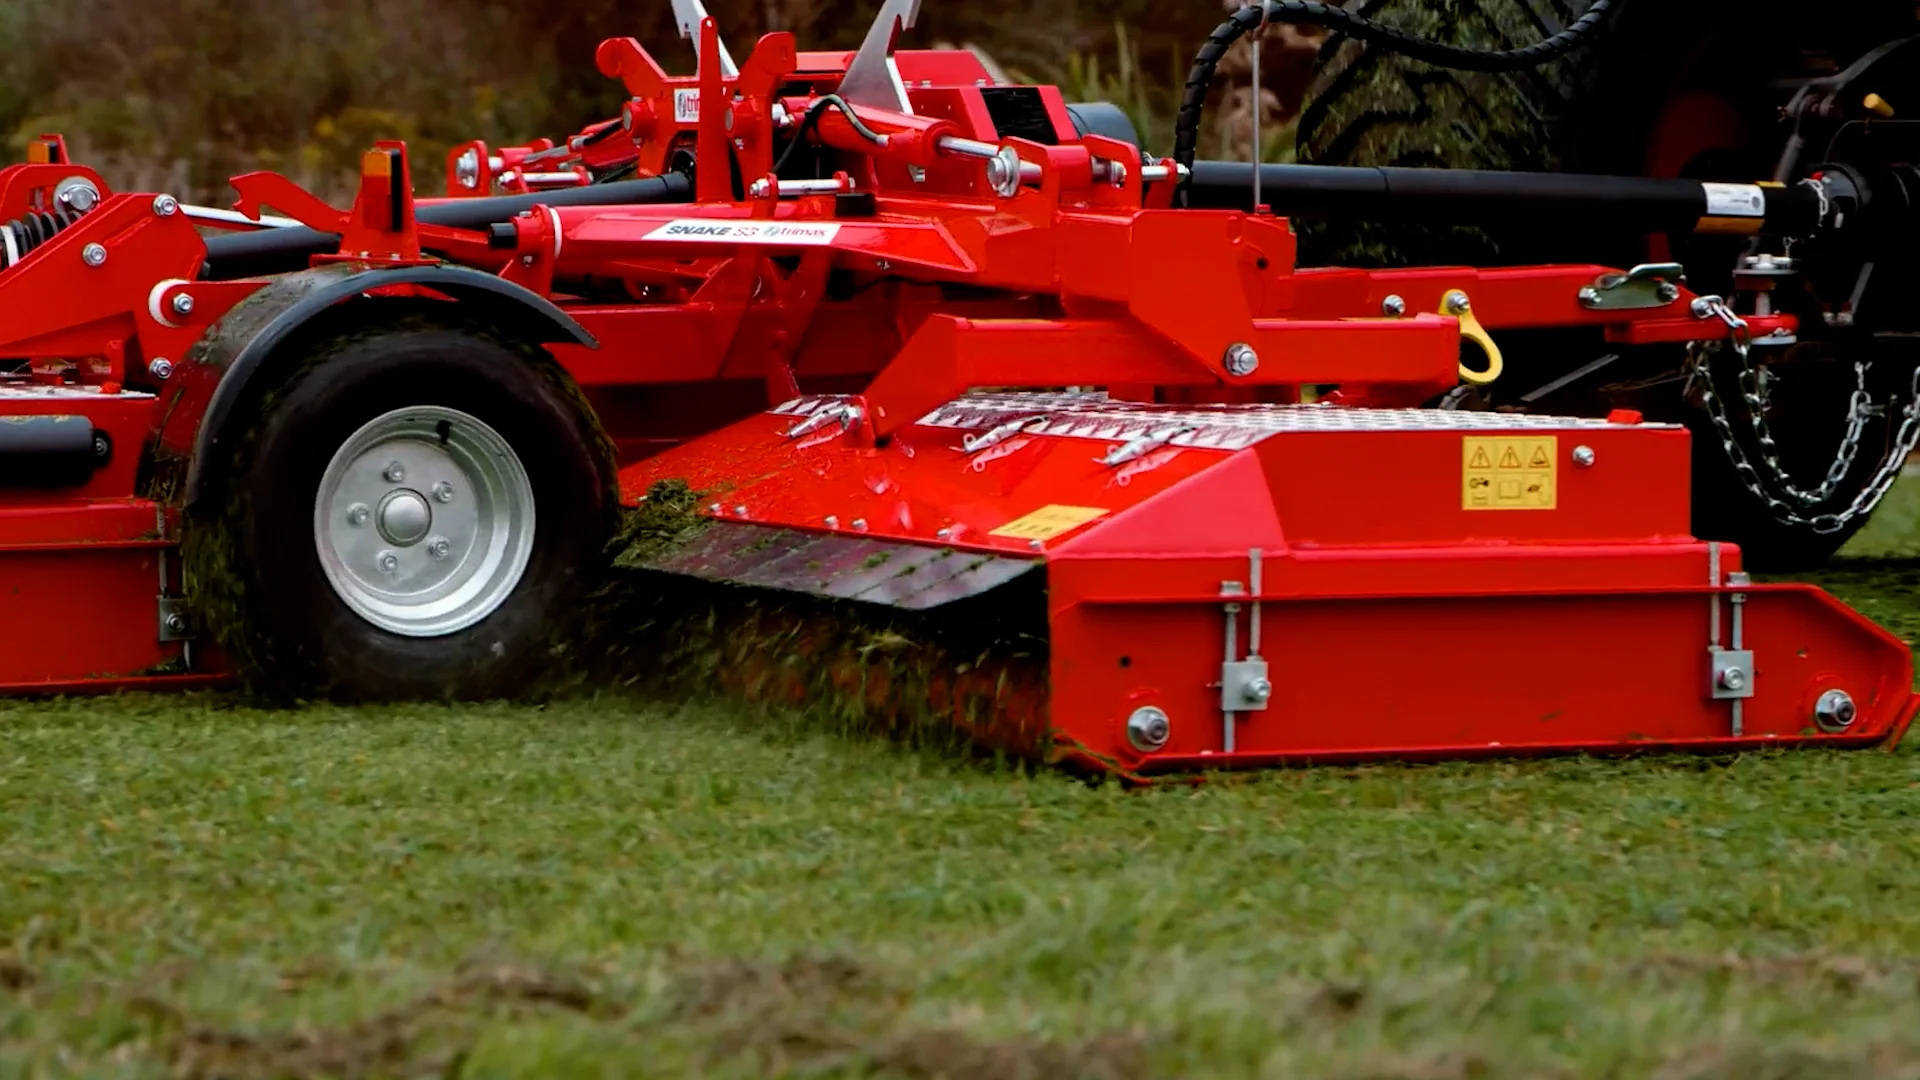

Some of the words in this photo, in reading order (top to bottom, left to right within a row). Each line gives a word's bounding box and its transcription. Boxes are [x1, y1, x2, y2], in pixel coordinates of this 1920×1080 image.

[666, 225, 732, 236] SNAKE
[733, 226, 759, 237] S3
[781, 227, 826, 237] trimax
